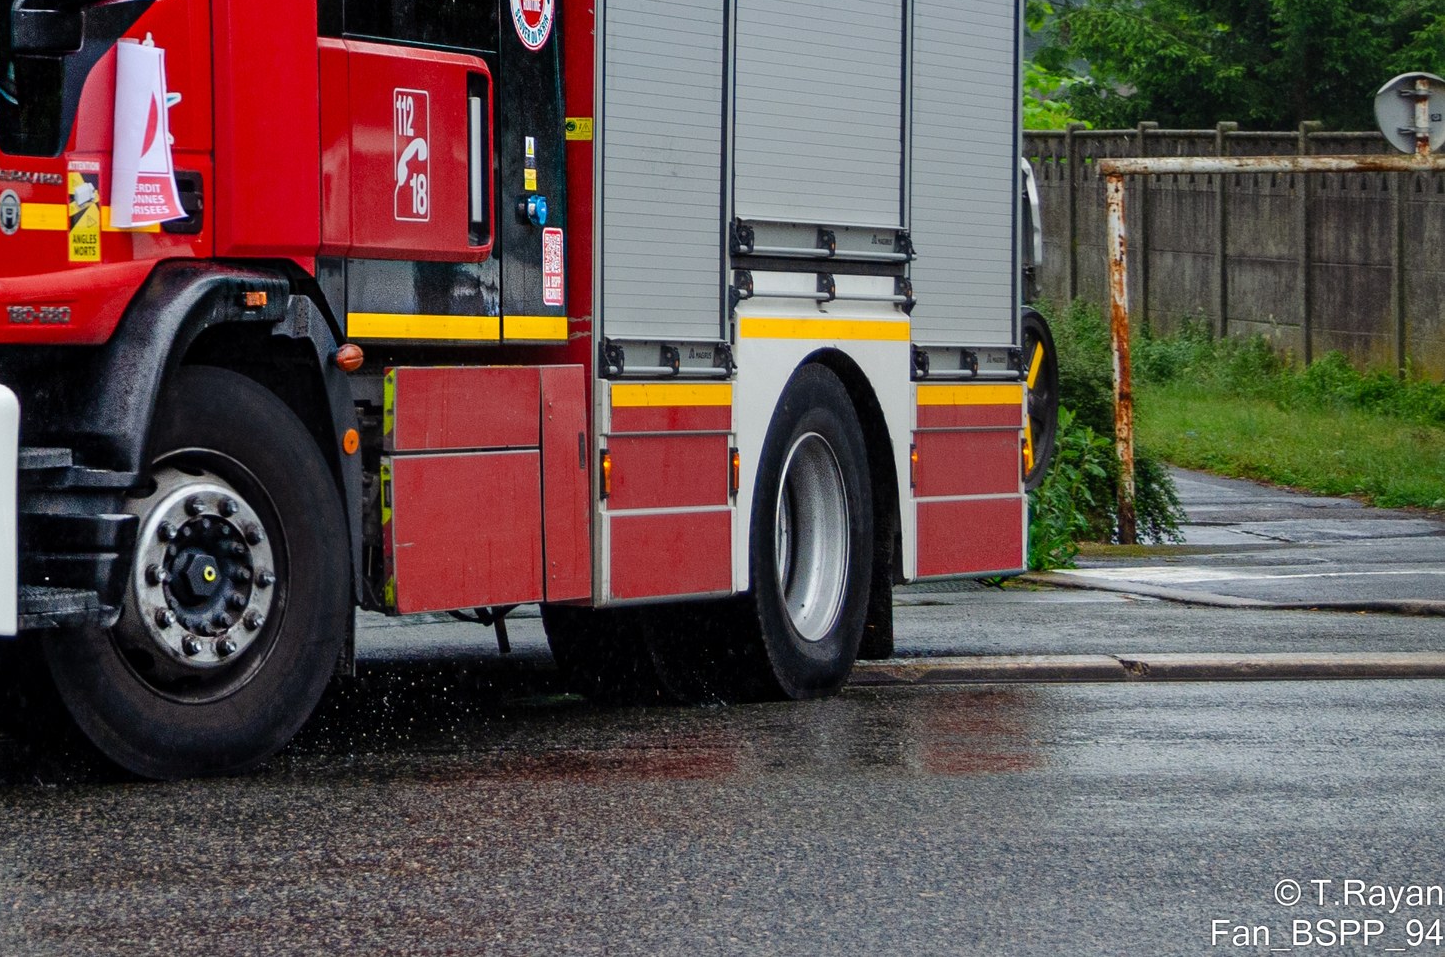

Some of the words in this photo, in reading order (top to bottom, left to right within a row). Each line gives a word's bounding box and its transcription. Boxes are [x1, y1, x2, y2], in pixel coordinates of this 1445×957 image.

[396, 94, 414, 137] 112
[135, 183, 161, 193] ERDIT
[409, 172, 427, 215] 18
[72, 234, 97, 244] ANGLES
[74, 246, 96, 256] MORTS
